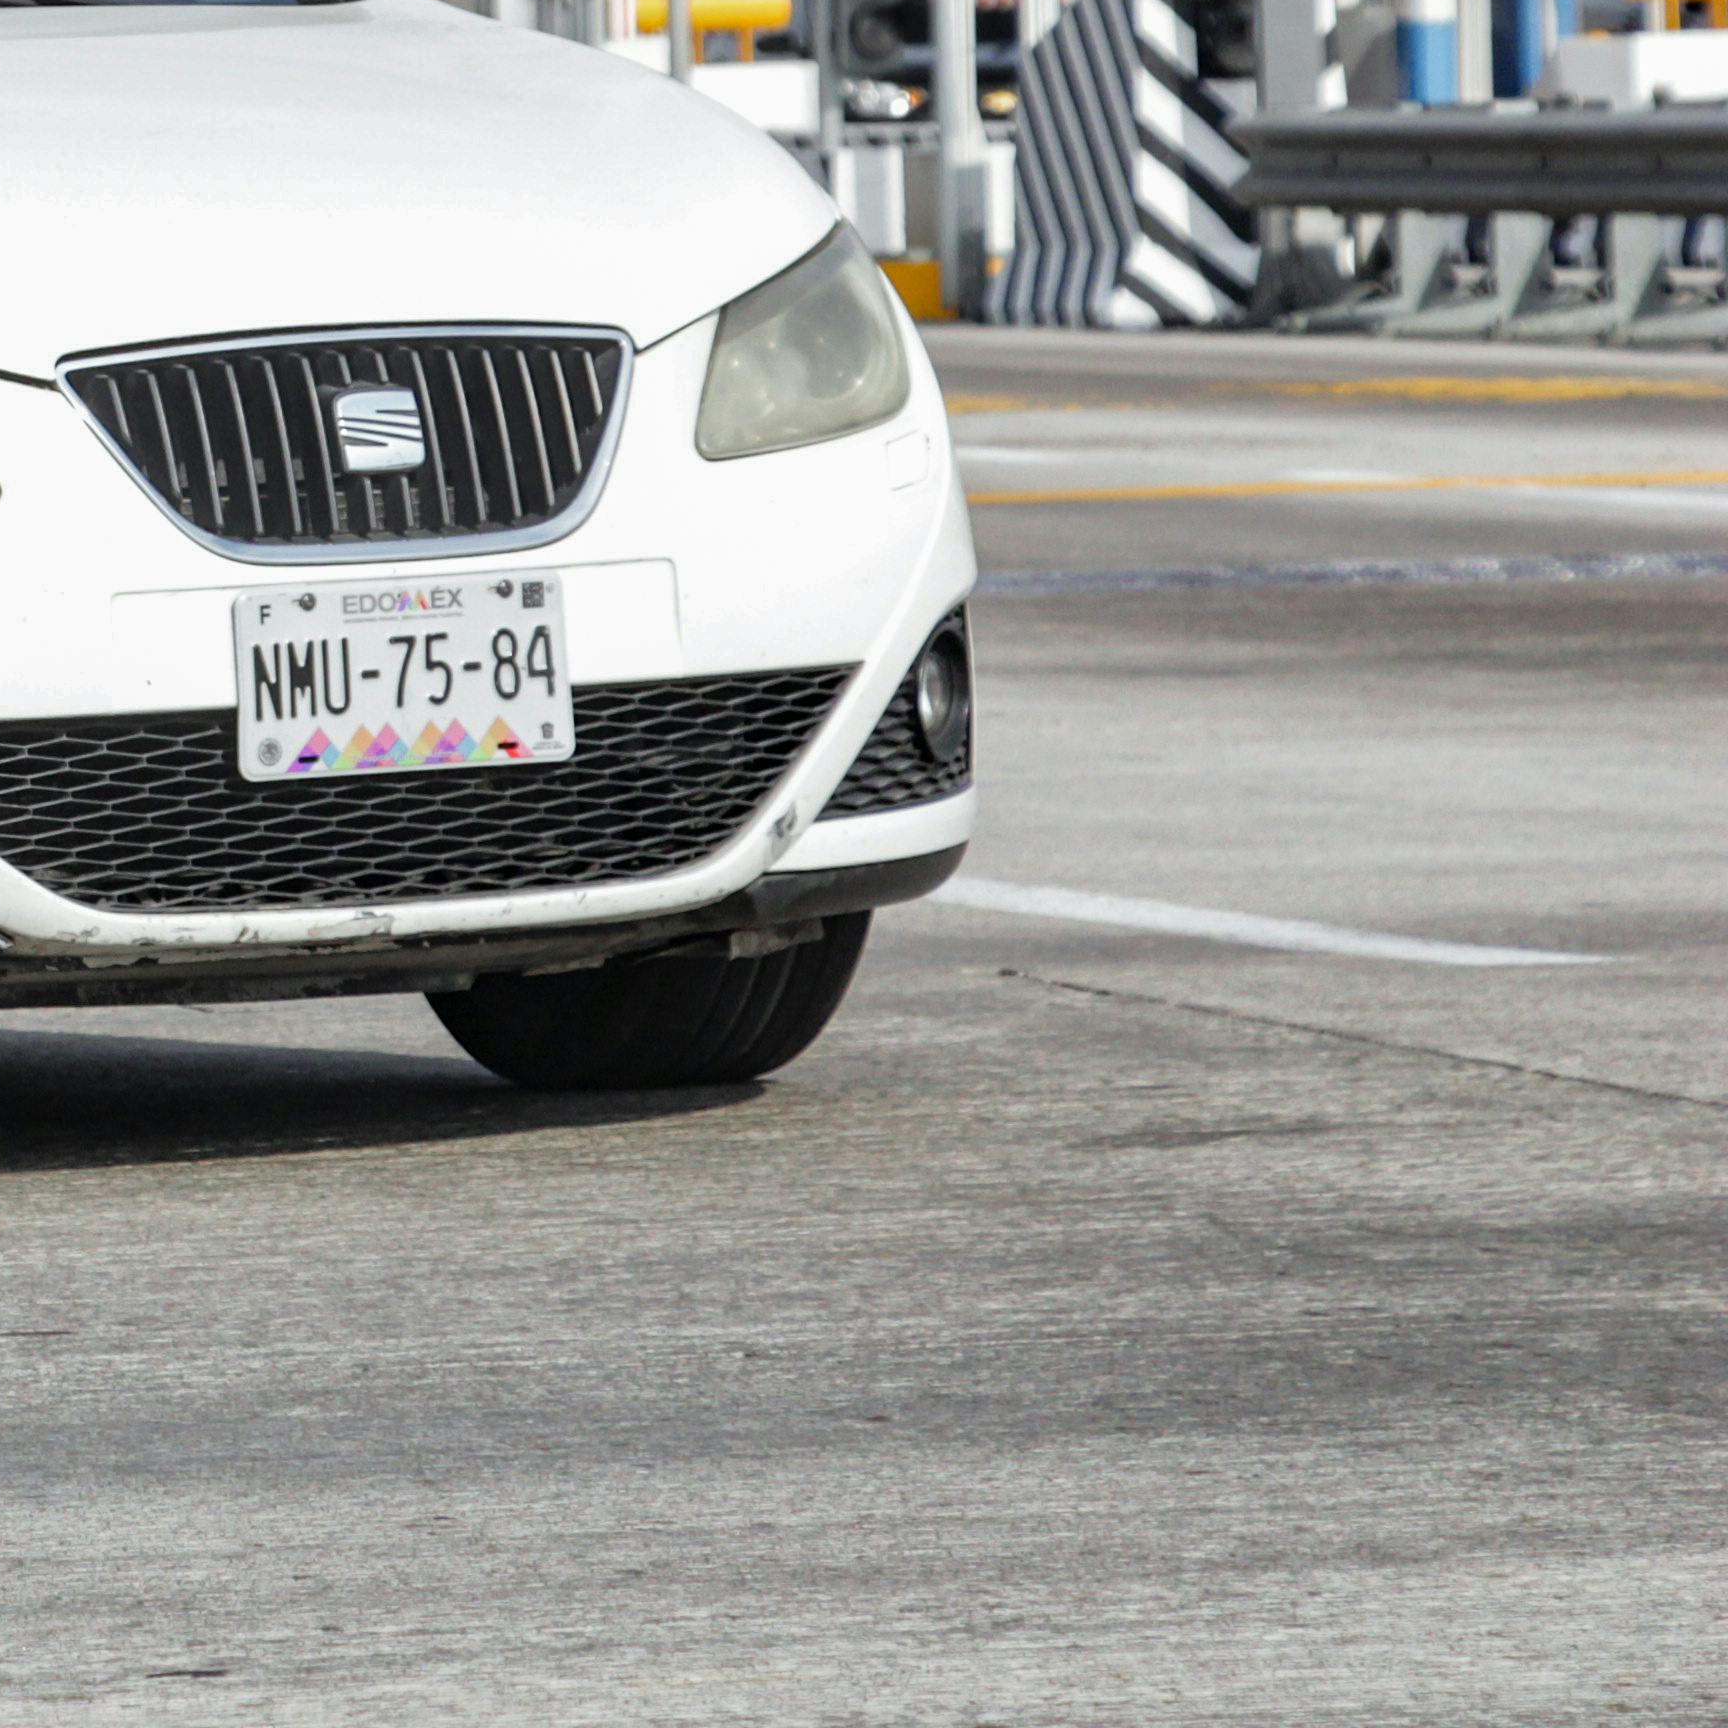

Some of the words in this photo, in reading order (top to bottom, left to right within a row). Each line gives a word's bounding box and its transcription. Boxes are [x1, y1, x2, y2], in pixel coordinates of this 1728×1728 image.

[259, 604, 272, 626] F
[342, 587, 464, 616] EDOMÉX
[253, 624, 555, 722] NMU-75-84
